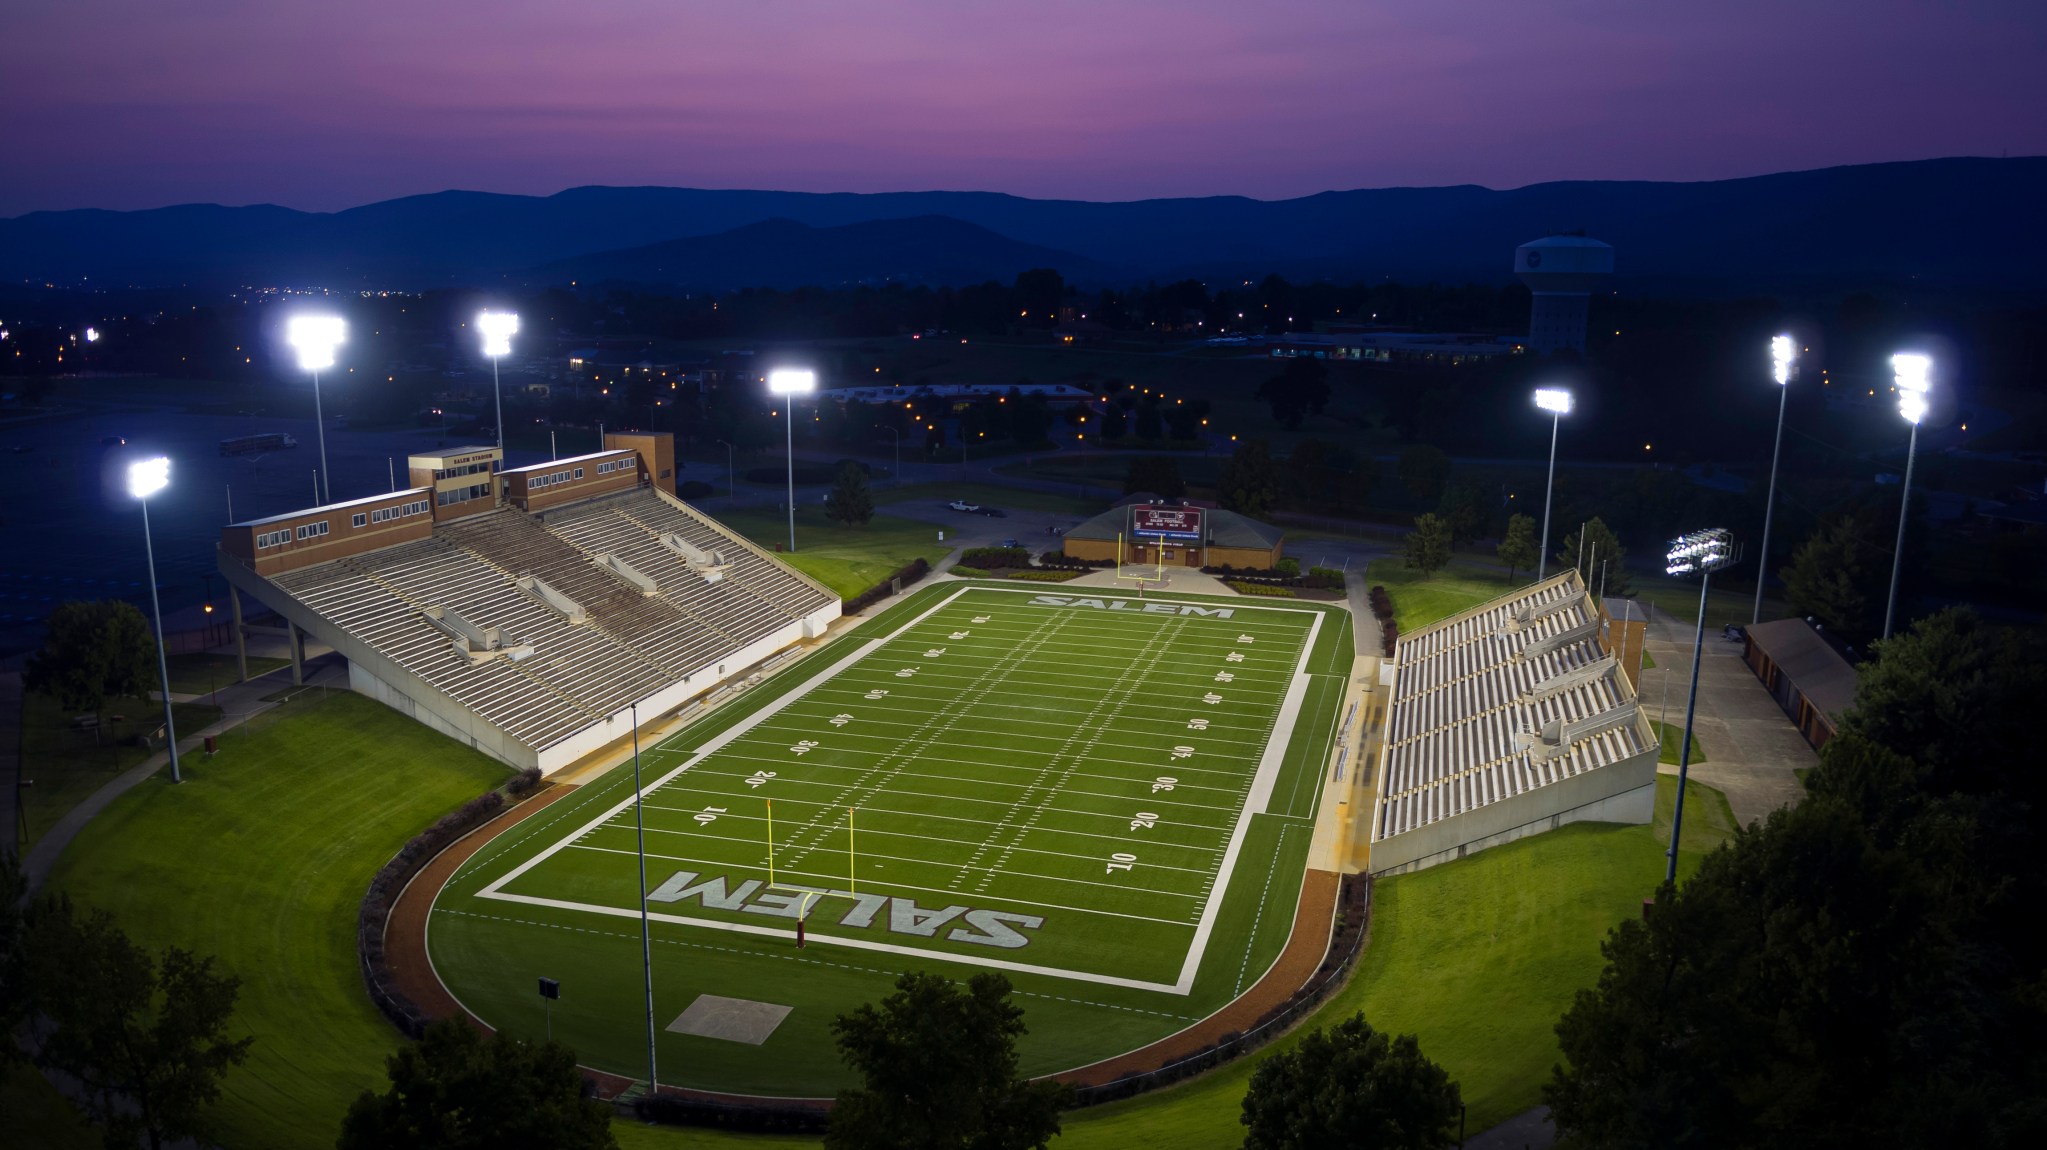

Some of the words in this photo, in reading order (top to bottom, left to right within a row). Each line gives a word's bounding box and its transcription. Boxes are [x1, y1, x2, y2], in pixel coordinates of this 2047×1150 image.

[472, 453, 493, 462] STADIUM
[1027, 595, 1235, 619] SALEM
[864, 689, 889, 700] 50
[829, 713, 854, 725] 40
[1187, 718, 1210, 730] 50
[790, 740, 819, 753] 30
[1171, 745, 1195, 758] 40
[744, 770, 777, 785] 20
[1152, 776, 1178, 791] 30
[693, 806, 728, 822] 10
[1130, 812, 1159, 829] 20
[1107, 852, 1137, 871] 10
[645, 869, 1047, 949] SALEM
